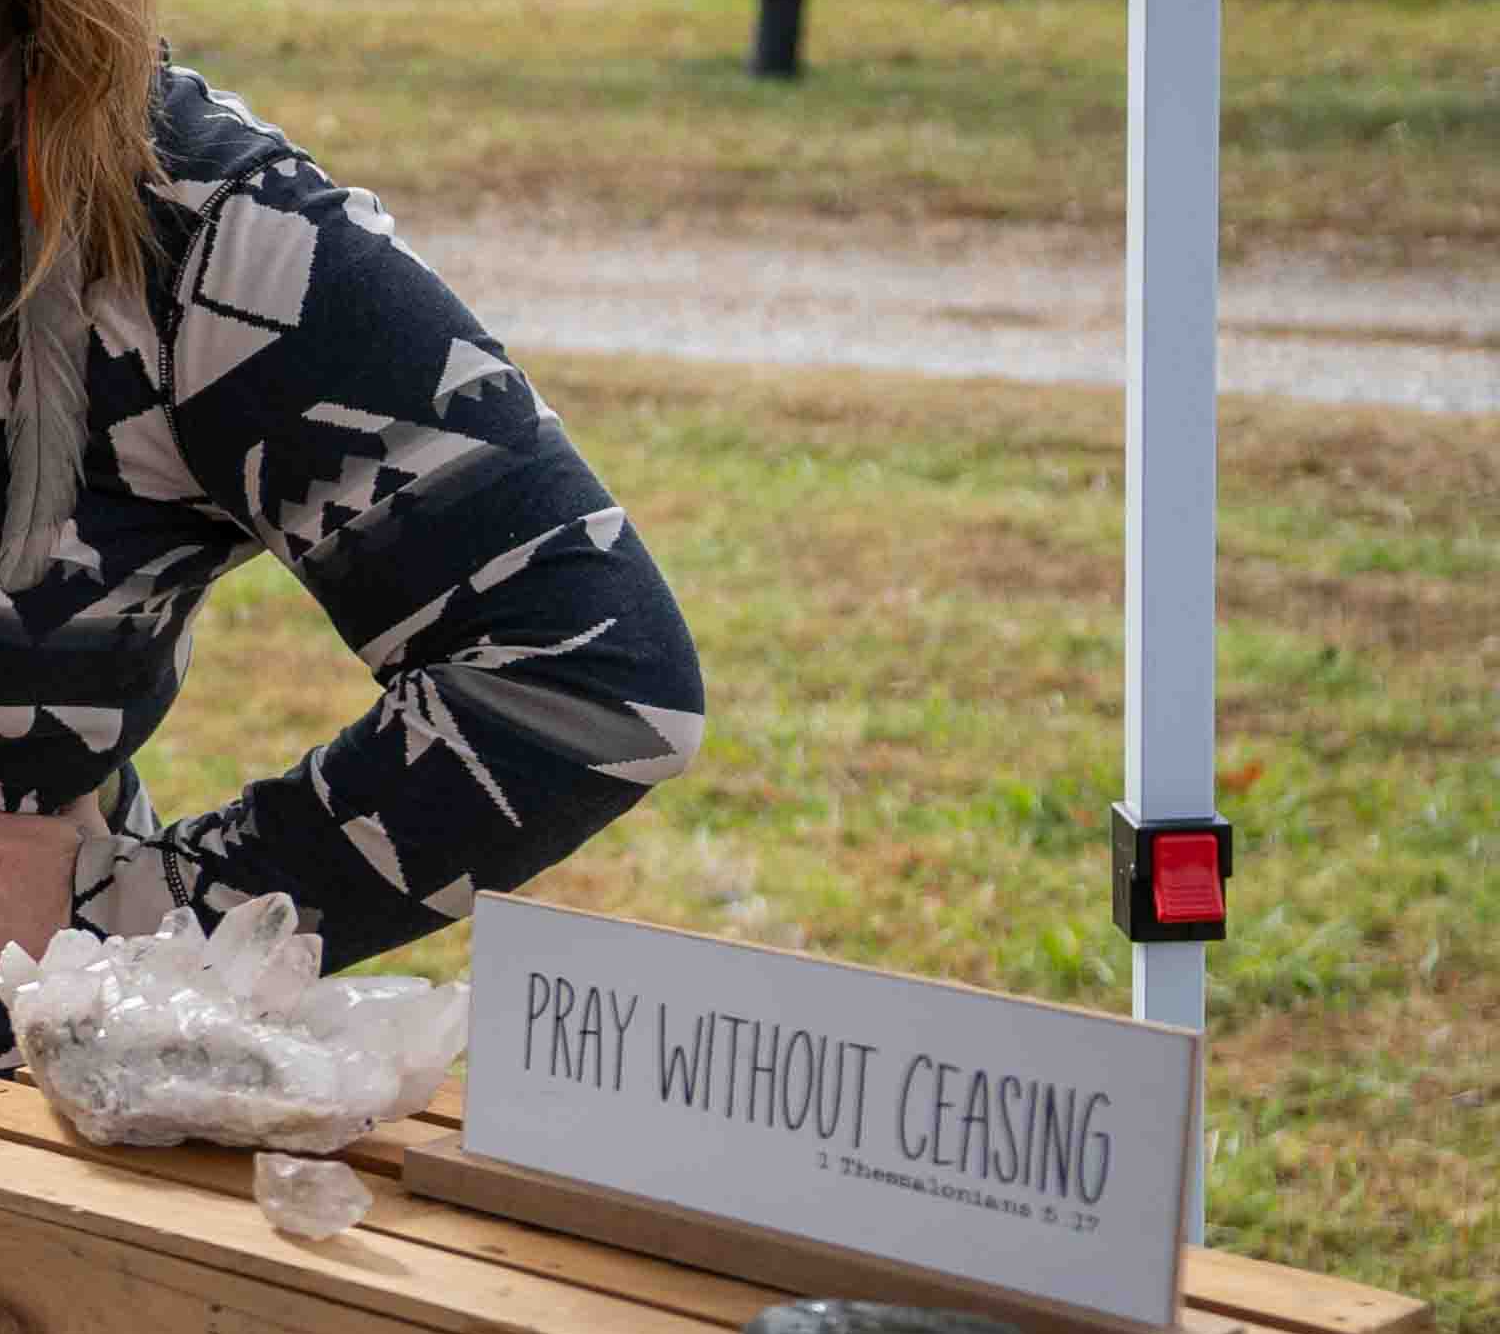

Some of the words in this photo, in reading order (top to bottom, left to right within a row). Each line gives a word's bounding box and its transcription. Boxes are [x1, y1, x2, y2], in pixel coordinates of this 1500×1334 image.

[524, 971, 638, 1092] PRAY
[659, 1001, 878, 1149] WITHOUT
[900, 1052, 1113, 1206] CEASING
[840, 1155, 1033, 1220] Thessalonians
